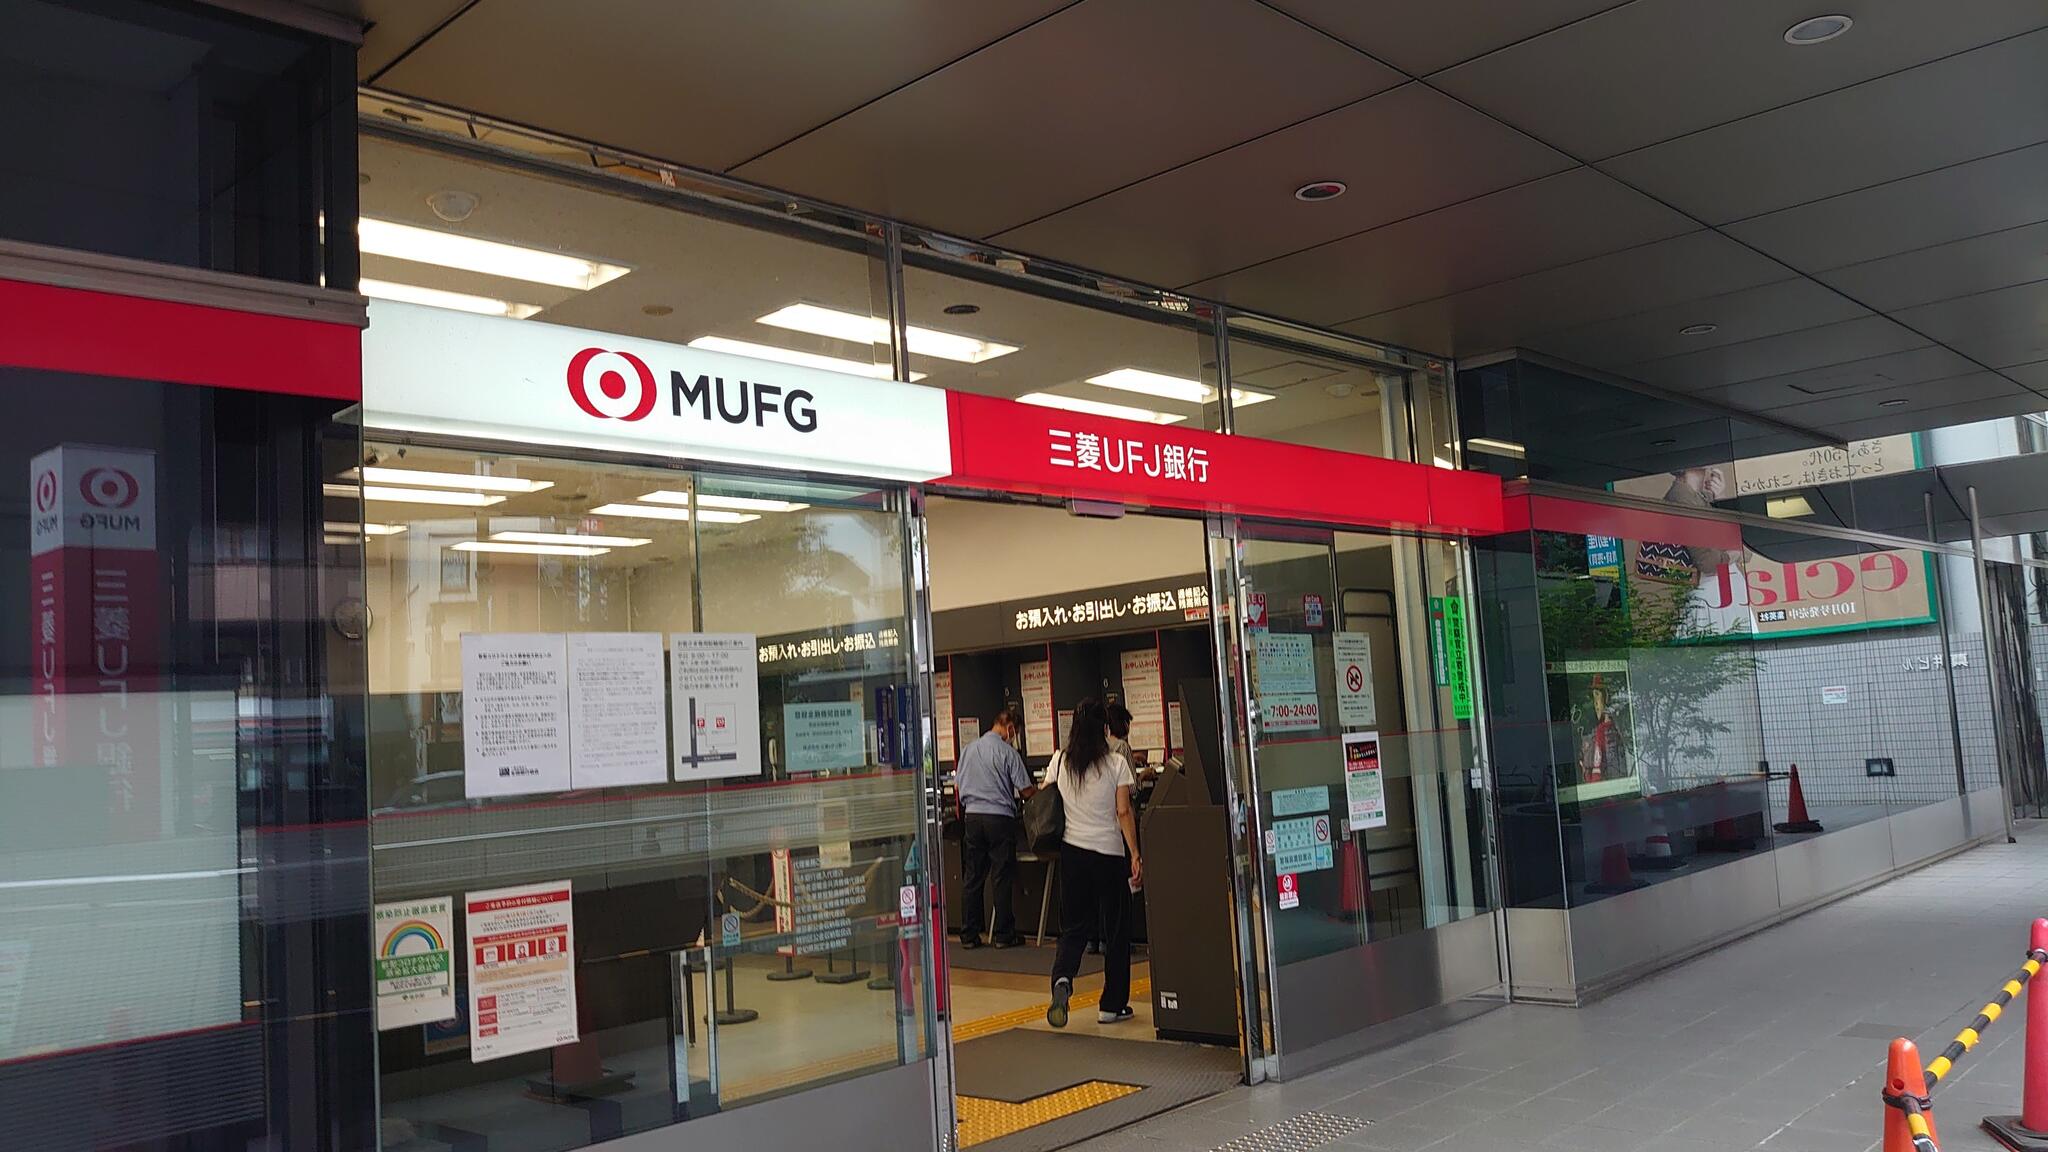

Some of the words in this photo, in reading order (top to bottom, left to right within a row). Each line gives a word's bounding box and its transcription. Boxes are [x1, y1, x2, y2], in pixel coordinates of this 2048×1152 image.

[670, 370, 818, 433] MUFG
[1048, 429, 1209, 483] 三菱UFJ銀行
[1015, 591, 1177, 630] お預入れ・お引出し・お振込
